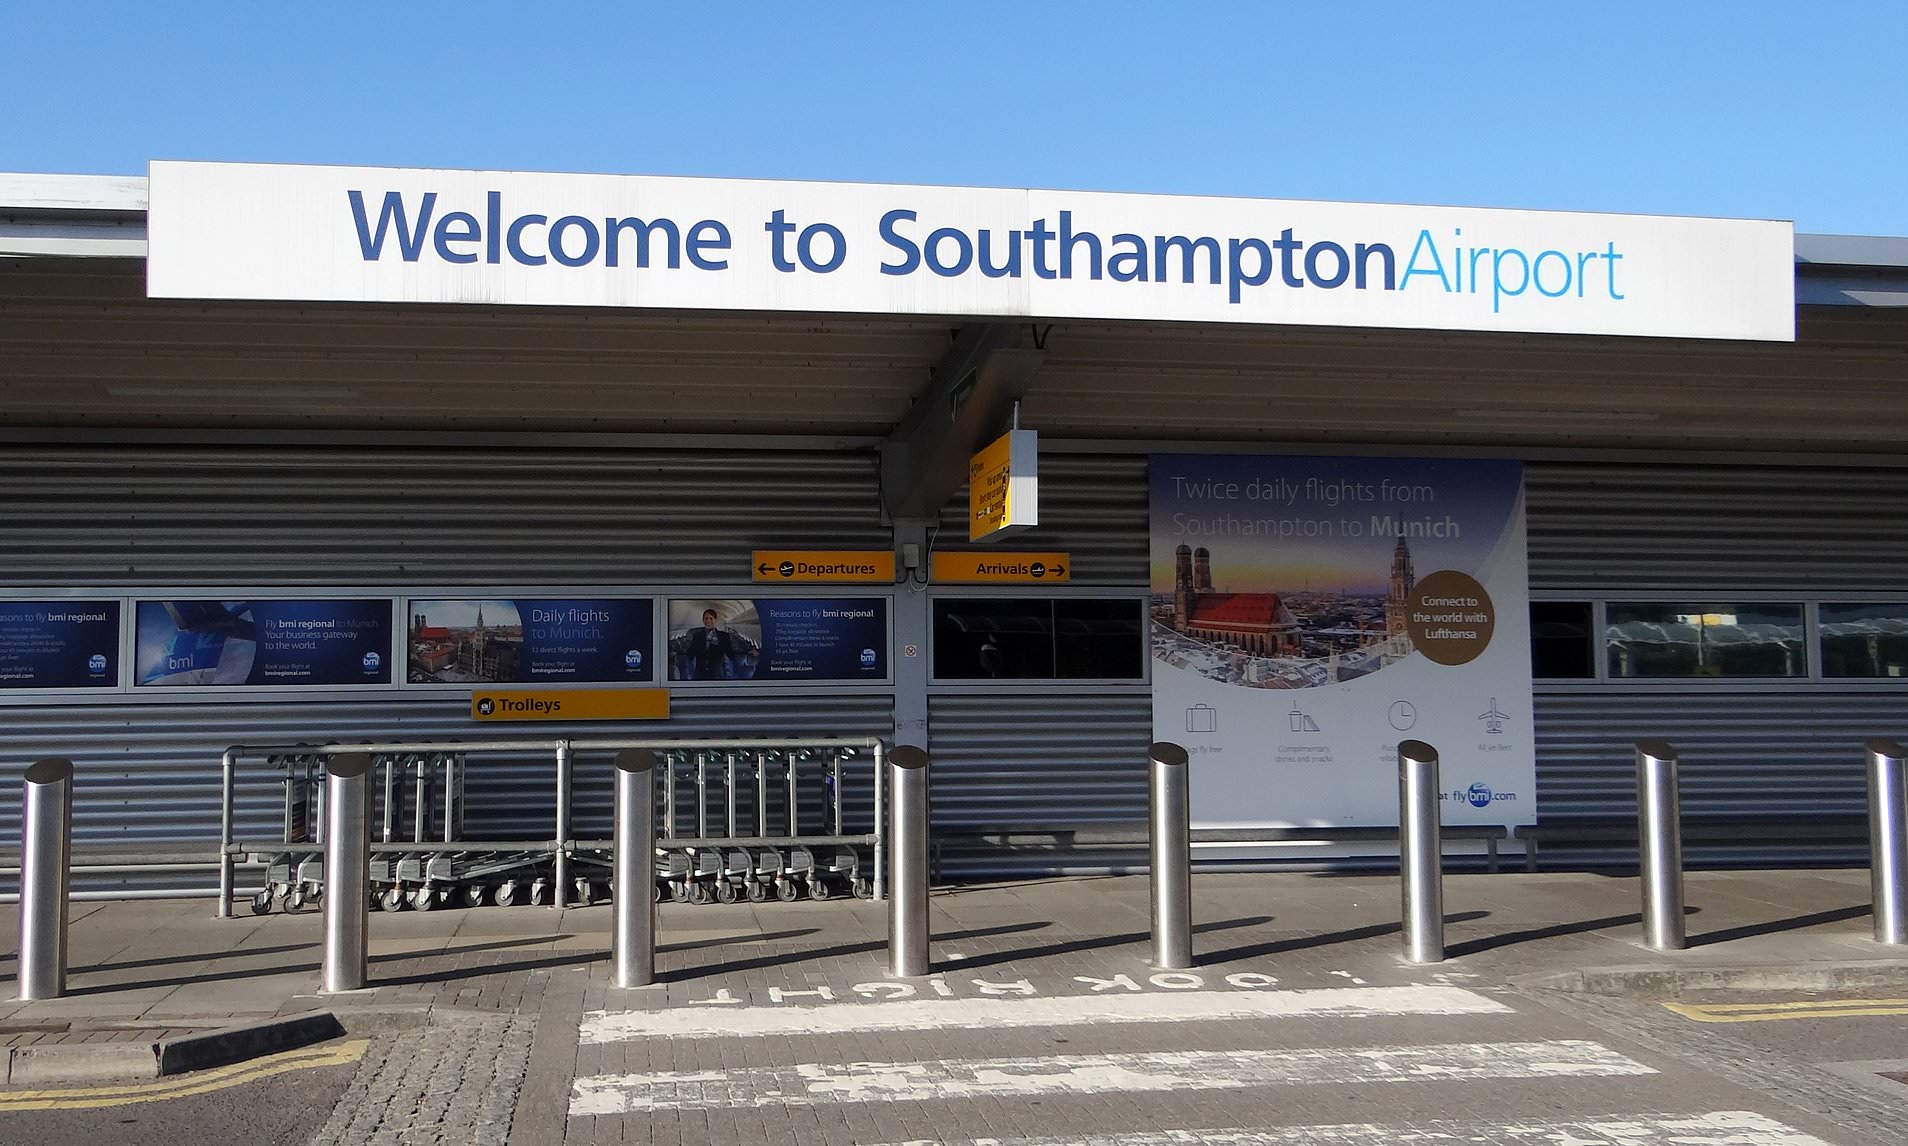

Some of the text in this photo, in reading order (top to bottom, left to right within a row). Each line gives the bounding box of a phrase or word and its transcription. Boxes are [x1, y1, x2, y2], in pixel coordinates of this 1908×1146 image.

[348, 191, 732, 271] Welcome
[765, 210, 847, 274] to
[1170, 476, 1434, 508] Twice daily flights from
[1173, 513, 1461, 542] Southampton to Munich
[798, 562, 876, 577] Departures
[976, 562, 1029, 576] Arrivals
[1422, 595, 1479, 607] Connect to
[48, 612, 66, 622] bmi
[67, 612, 106, 624] regional
[531, 608, 610, 626] Daily flights
[770, 609, 801, 619] Reasons
[802, 609, 811, 618] to
[822, 608, 839, 618] bmi
[840, 608, 875, 620] regional
[1412, 611, 1488, 623] the world with
[265, 619, 278, 630] Fly
[279, 619, 297, 629] bmi
[298, 619, 335, 630] regional
[265, 630, 358, 641] Your business gateway
[532, 628, 547, 640] to
[1424, 628, 1477, 640] Lufthansa
[265, 641, 275, 650] to
[276, 641, 290, 650] the
[89, 658, 106, 669] bmi
[168, 653, 194, 670] bmi
[363, 655, 380, 666] bmi
[625, 655, 641, 665] bmi
[860, 653, 876, 663] bmi
[499, 698, 561, 714] Trolleys
[688, 978, 1035, 1004] RIGHT
